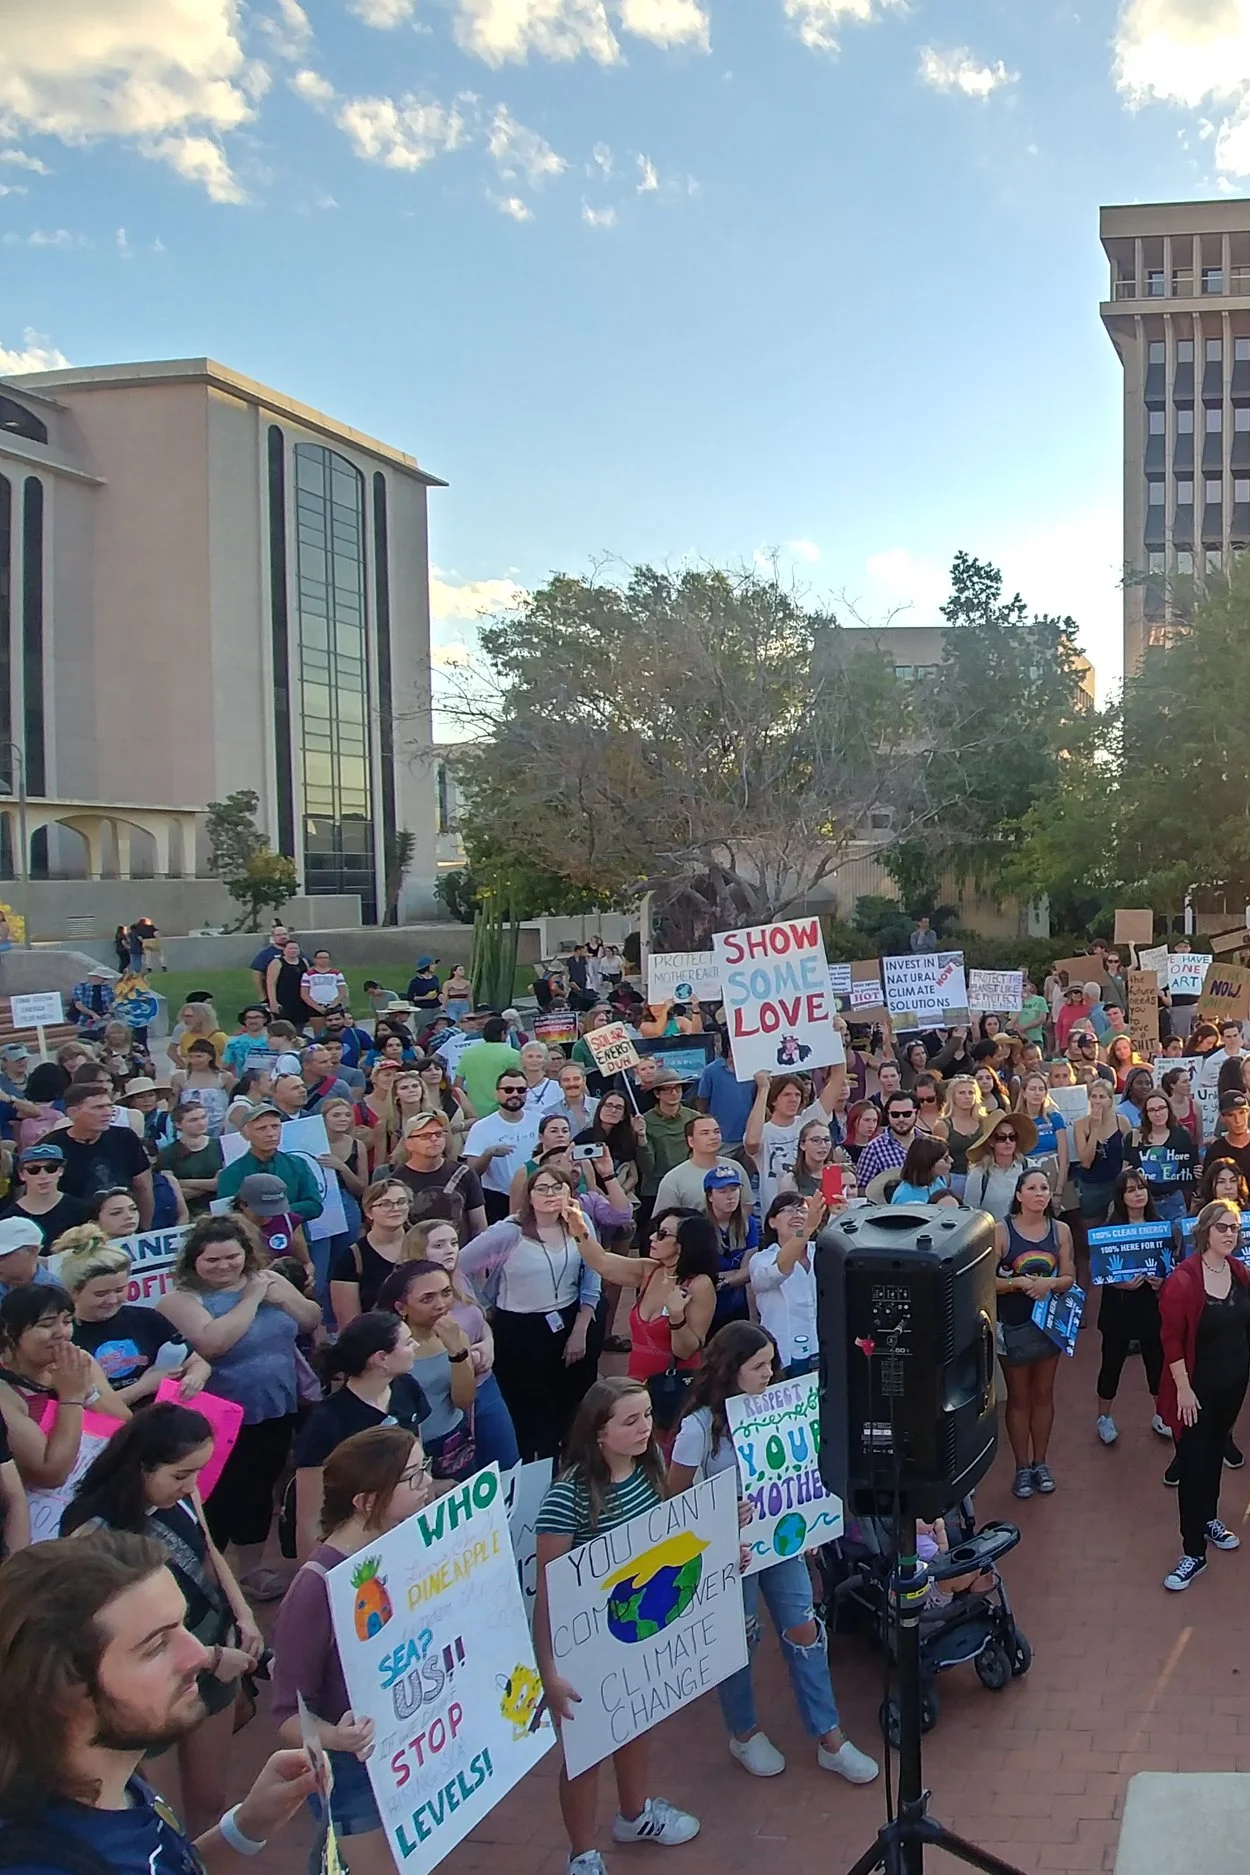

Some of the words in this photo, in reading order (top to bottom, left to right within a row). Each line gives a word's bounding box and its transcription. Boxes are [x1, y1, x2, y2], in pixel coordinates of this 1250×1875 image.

[723, 920, 819, 965] SHOW
[653, 954, 714, 969] PROTECT
[885, 959, 921, 971] INVEST
[923, 958, 936, 968] IN
[1170, 964, 1201, 975] ONE
[1182, 955, 1210, 964] HAVE
[727, 955, 825, 1006] SOME
[886, 971, 937, 985] NATURAL
[888, 985, 936, 998] CLIMATE
[1171, 976, 1204, 988] ART
[854, 992, 880, 1002] HOT
[890, 998, 951, 1011] SOLUTIONS
[734, 992, 830, 1038] LOVE
[590, 1027, 627, 1051] SOLAR
[1132, 1038, 1157, 1051] SHIT
[596, 1041, 633, 1065] ENERGY
[607, 1055, 632, 1072] DUH
[1138, 1149, 1158, 1162] We
[1166, 1148, 1191, 1161] Have
[1162, 1166, 1194, 1182] Earth
[1092, 1230, 1112, 1241] 100%
[1113, 1227, 1138, 1238] CLEAN
[1139, 1224, 1169, 1235] ENERGY
[121, 1231, 190, 1263] ANE
[1100, 1245, 1120, 1255] 100%
[1120, 1243, 1141, 1253] HERE
[1141, 1242, 1156, 1252] FOR
[1156, 1241, 1164, 1250] IT
[126, 1272, 177, 1302] OFI
[743, 1383, 803, 1418] RESPECT
[416, 1470, 499, 1548] WHO
[747, 1468, 831, 1525] MOTHE
[568, 1523, 633, 1587] YOU
[648, 1476, 722, 1544] CAN'T
[406, 1530, 500, 1613] PINEAPPLE
[677, 1562, 736, 1619] OVER
[377, 1628, 434, 1690] SEA?
[601, 1612, 718, 1713] CLIMATE
[393, 1635, 467, 1721] US!!
[611, 1655, 712, 1744] CHANGE
[390, 1701, 464, 1789] STOP
[393, 1747, 494, 1860] LEVELS!
